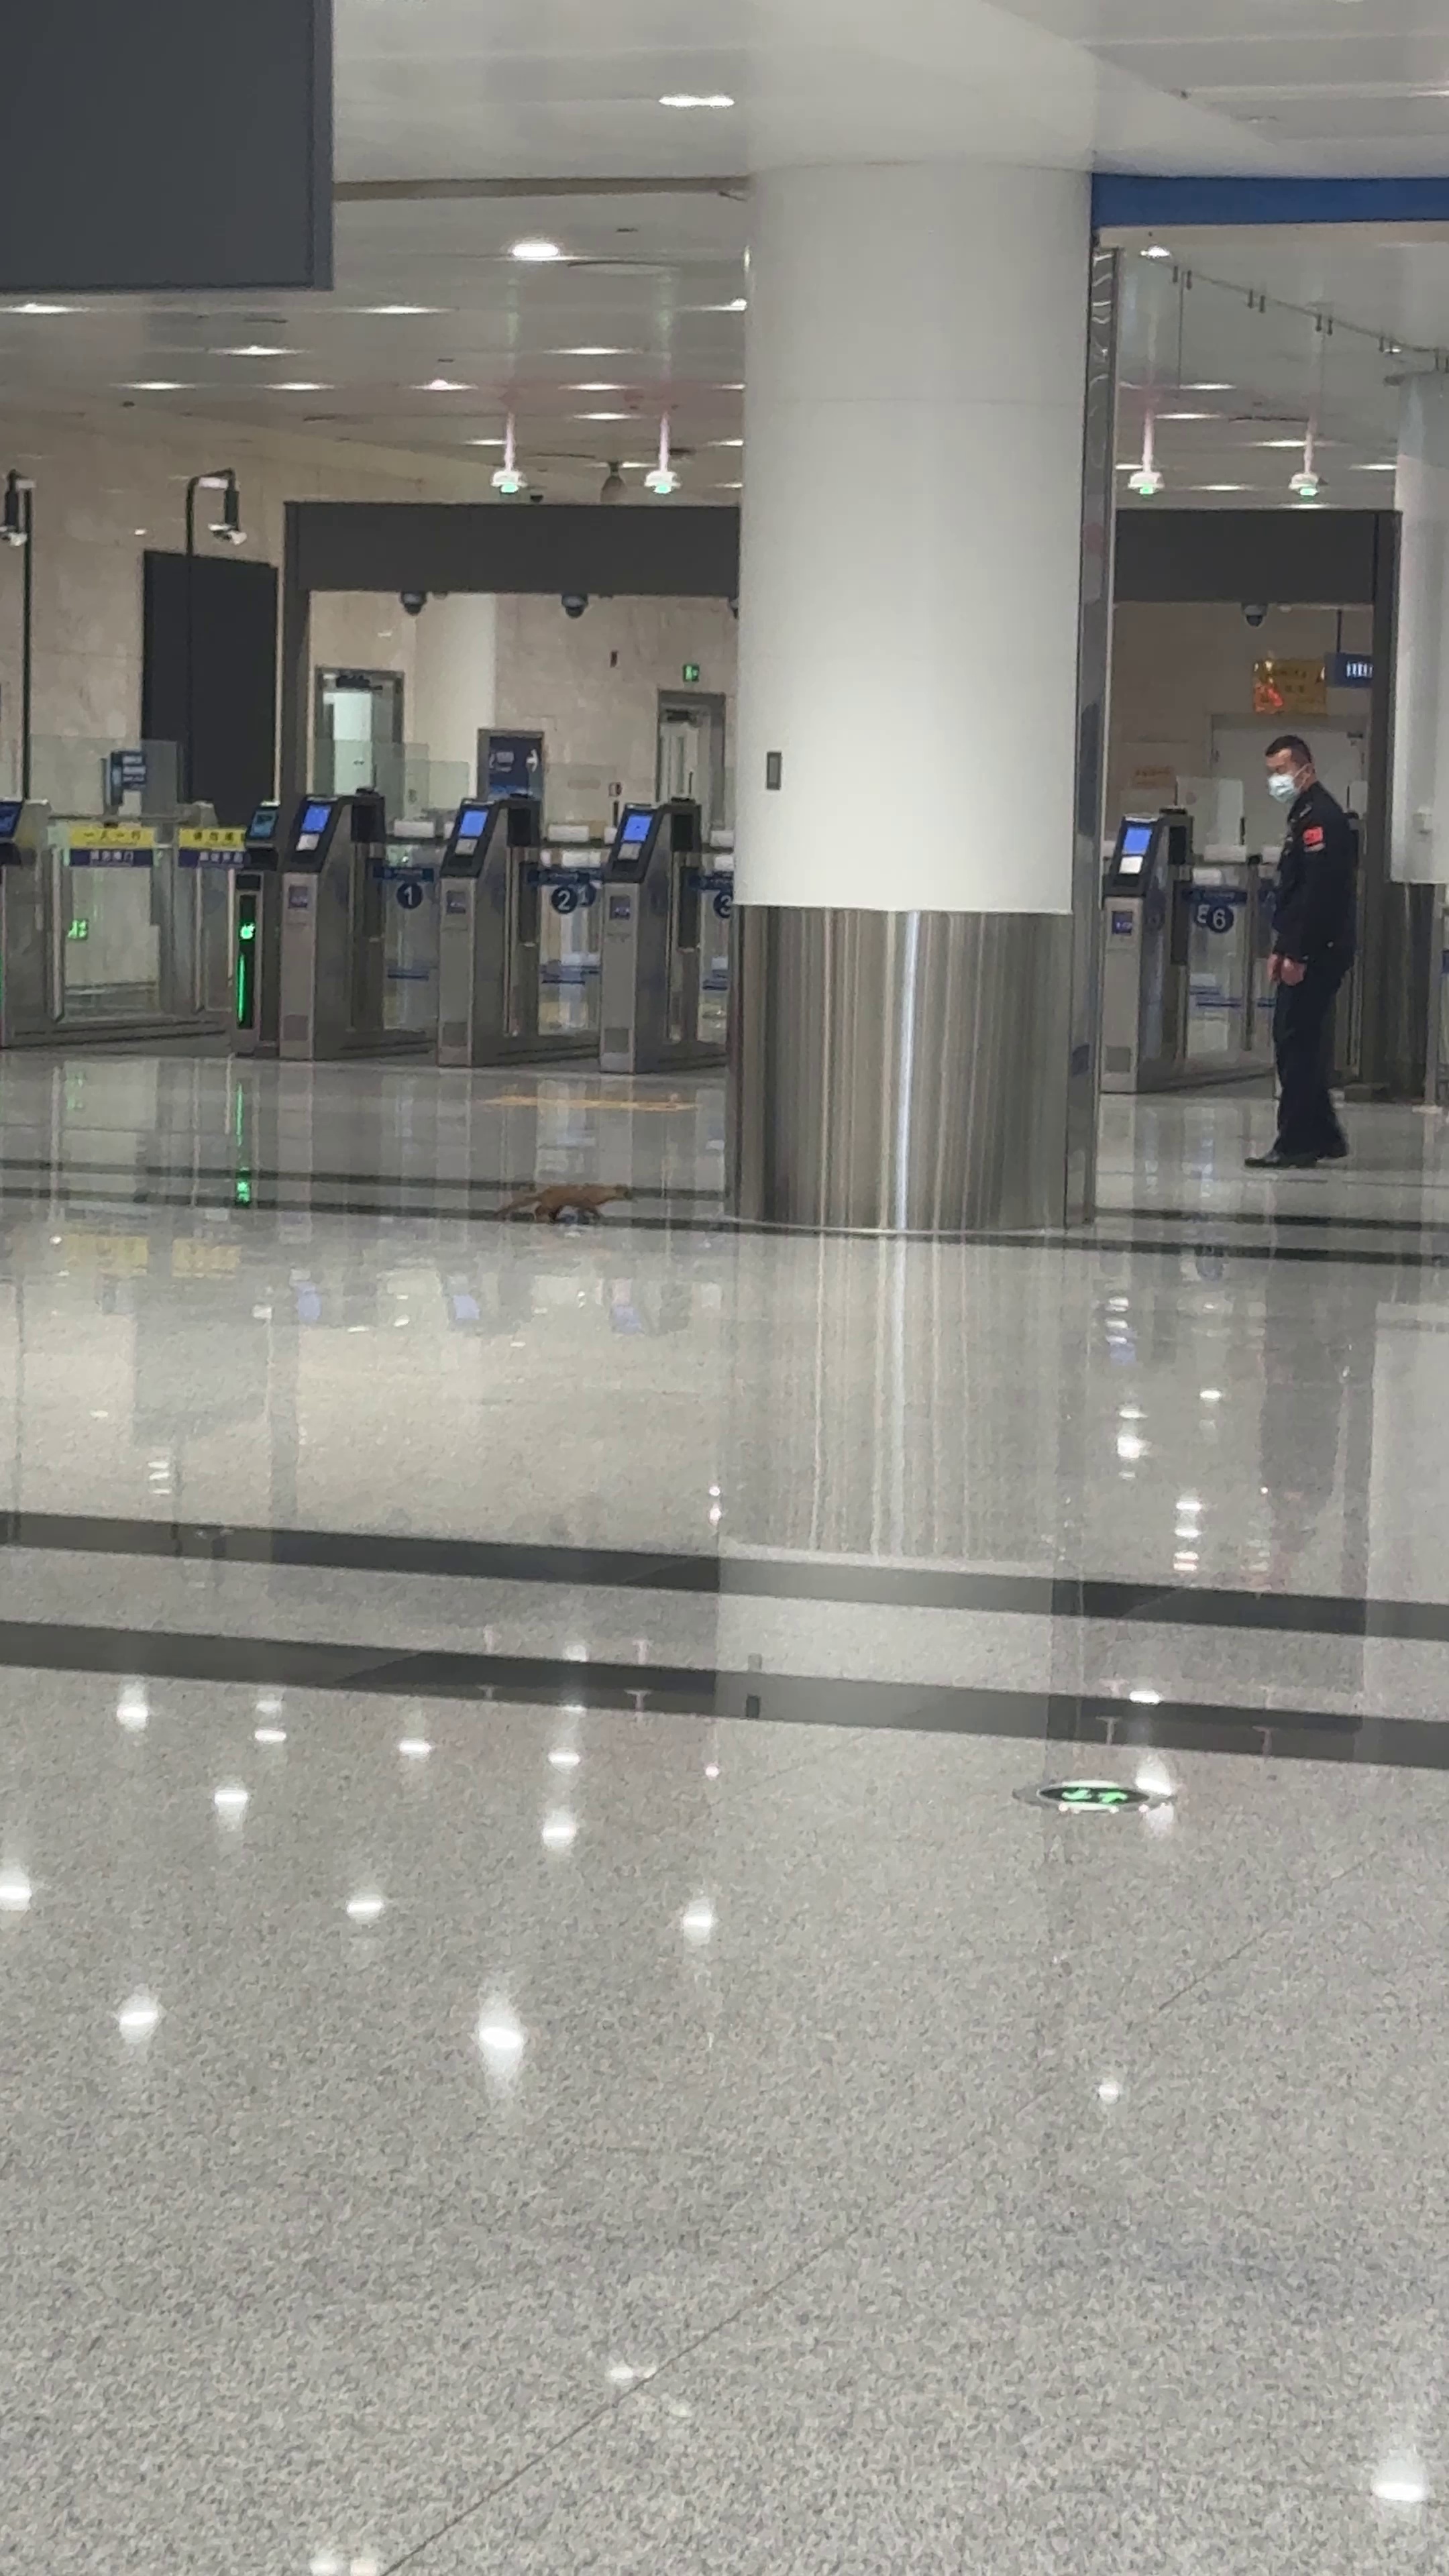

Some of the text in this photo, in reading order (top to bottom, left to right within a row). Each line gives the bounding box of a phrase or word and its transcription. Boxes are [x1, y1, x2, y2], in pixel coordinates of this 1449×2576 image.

[404, 885, 413, 906] 1
[558, 890, 570, 910] 2
[1213, 909, 1226, 930] 6
